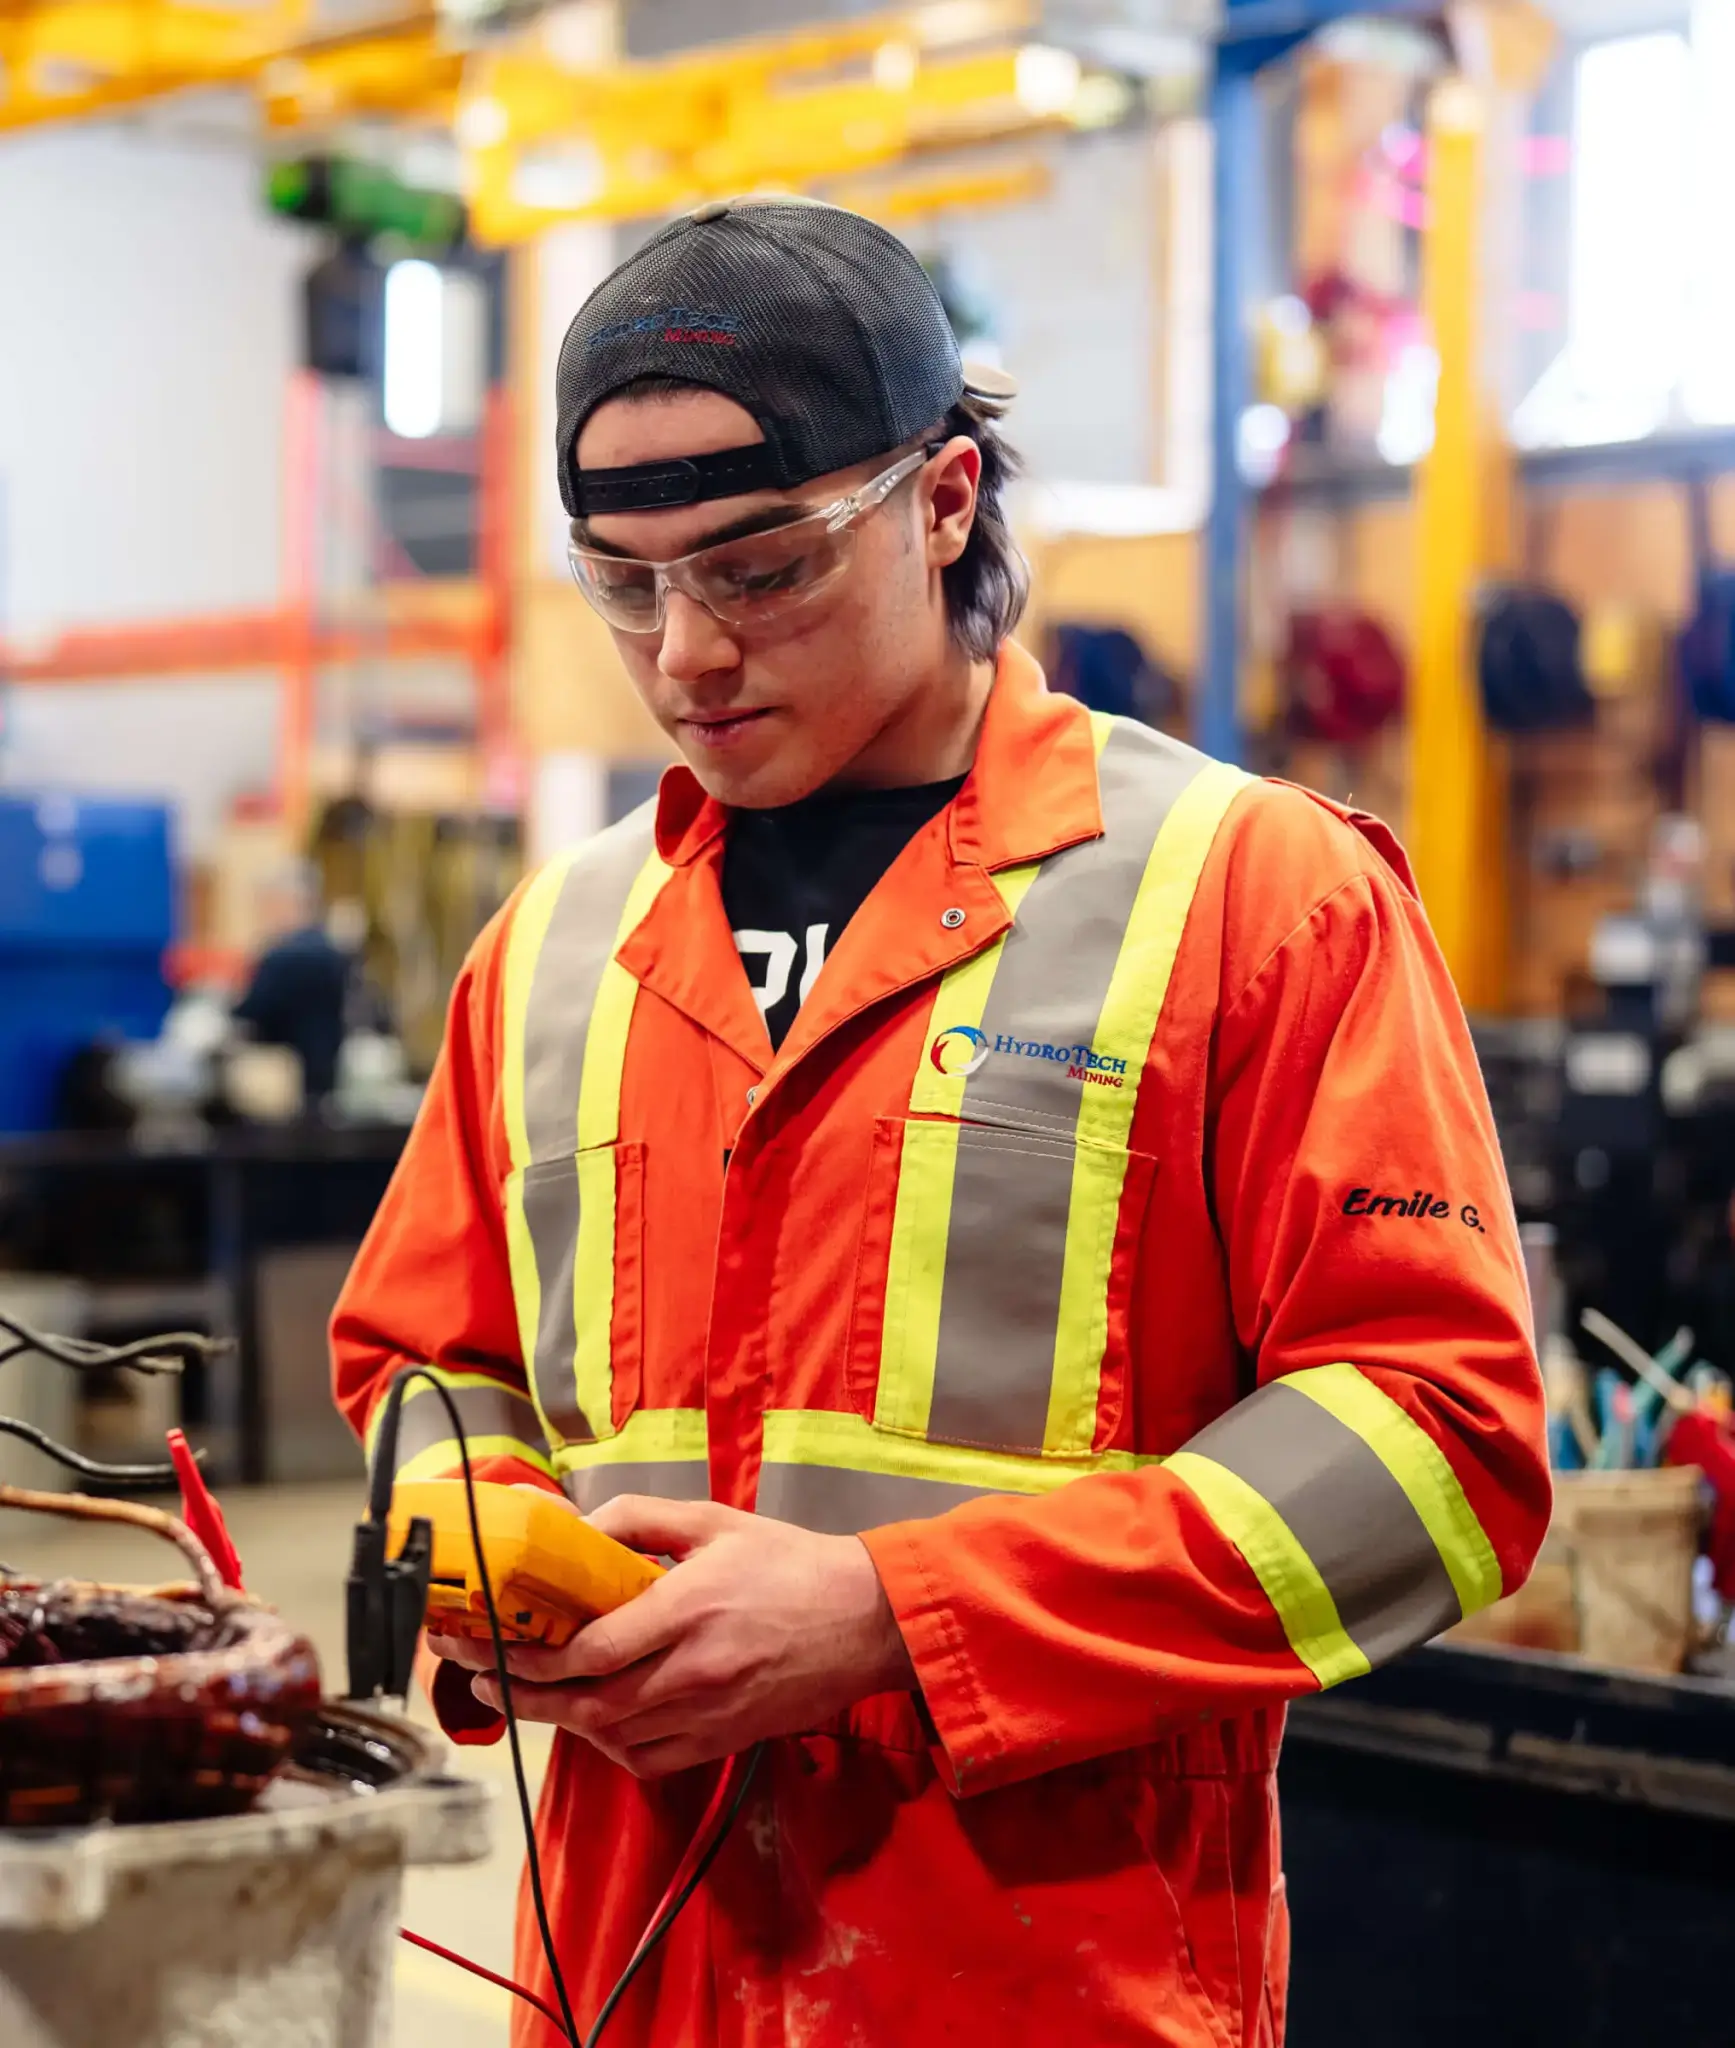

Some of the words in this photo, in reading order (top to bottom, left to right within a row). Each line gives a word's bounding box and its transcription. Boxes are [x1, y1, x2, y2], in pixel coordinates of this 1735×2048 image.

[994, 1033, 1128, 1074] HYDROTECH
[1066, 1064, 1124, 1088] MINING
[1342, 1188, 1450, 1219] Emile
[1460, 1204, 1486, 1233] G.
